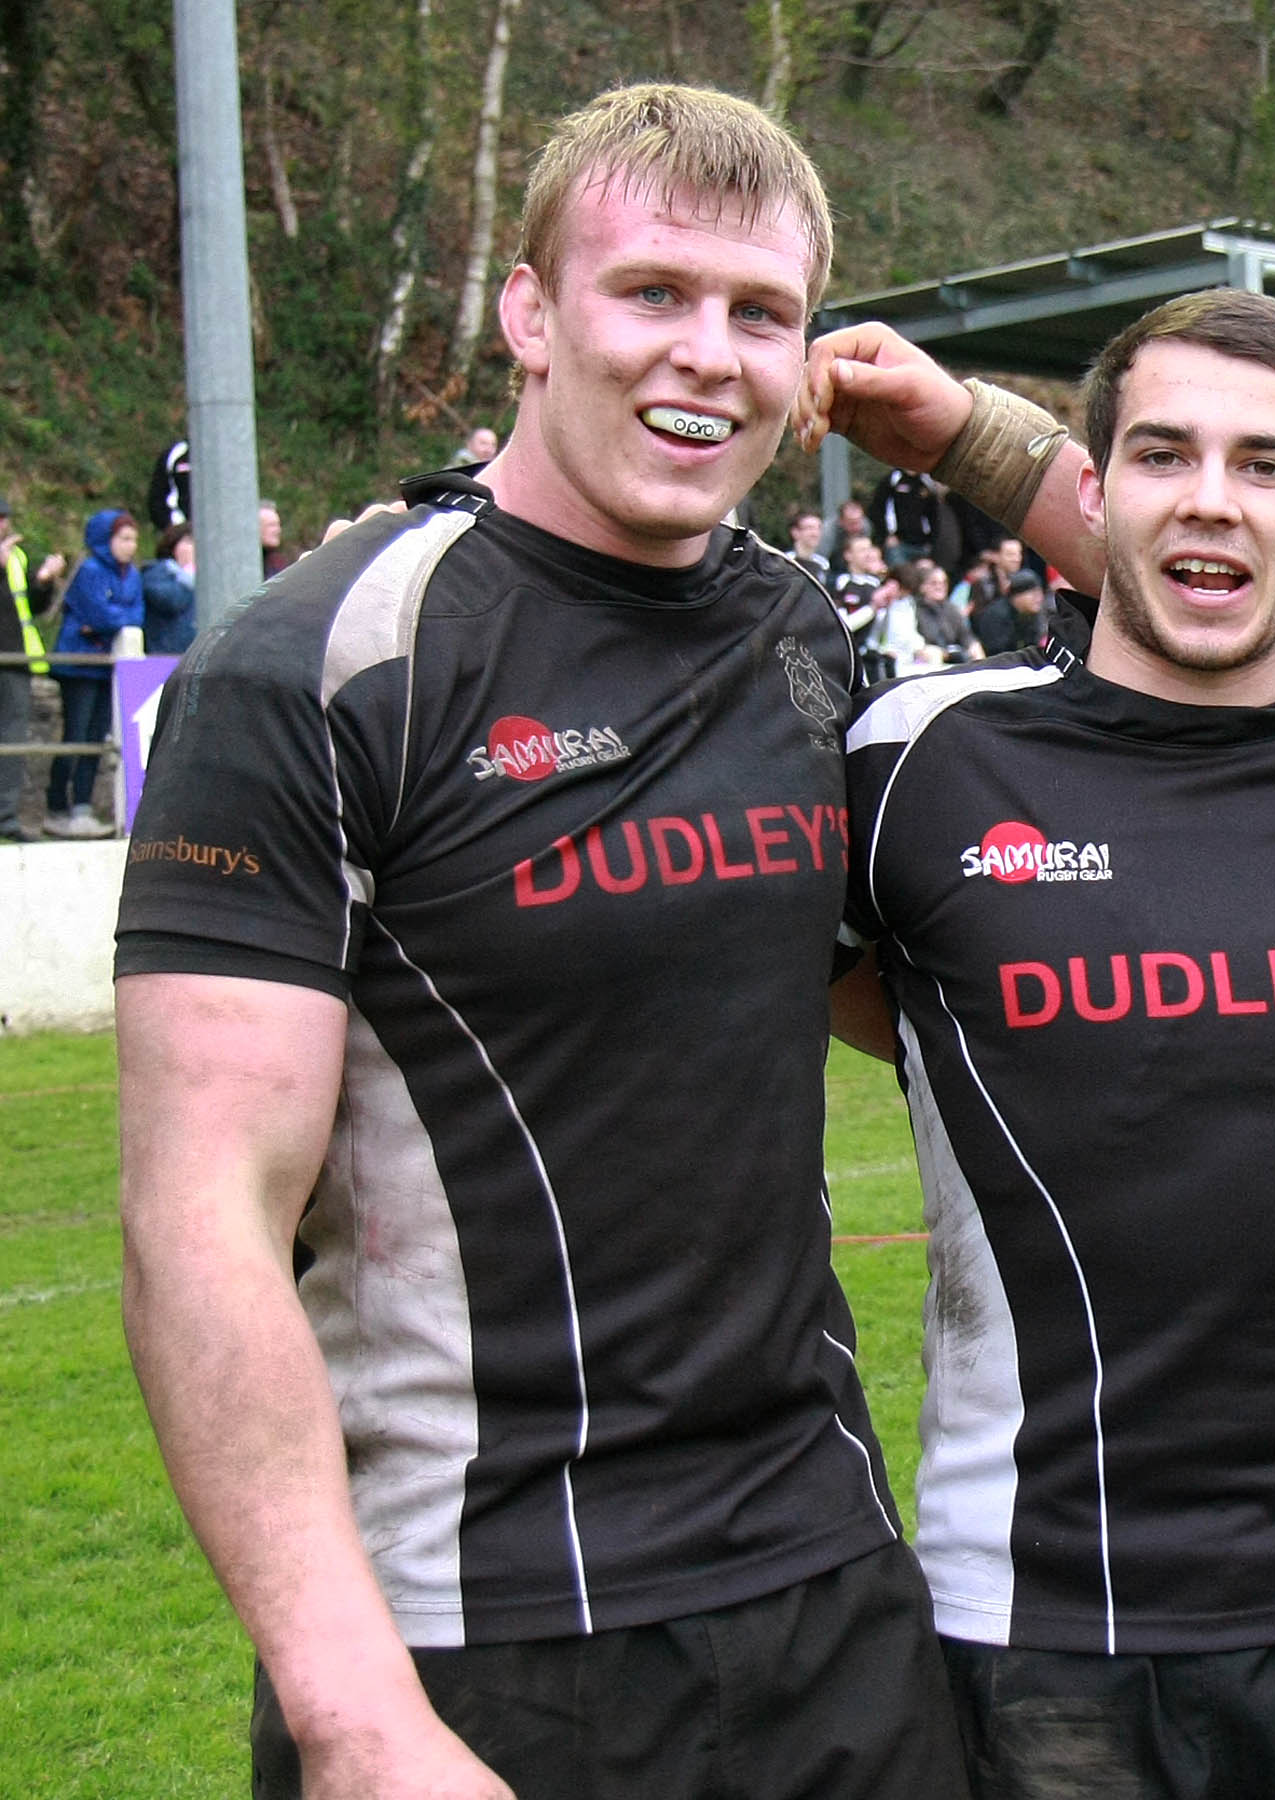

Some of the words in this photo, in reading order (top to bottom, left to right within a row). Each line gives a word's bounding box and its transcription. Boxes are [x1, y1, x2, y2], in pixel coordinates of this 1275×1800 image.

[674, 418, 714, 437] opro
[466, 726, 623, 781] SAMURAI
[555, 755, 597, 773] RUGBY
[599, 745, 632, 762] GEAR
[129, 835, 261, 875] Sainsbury's
[960, 841, 1110, 878] SAMURAI
[1036, 870, 1078, 882] RUGBY
[1079, 869, 1113, 881] GEAR
